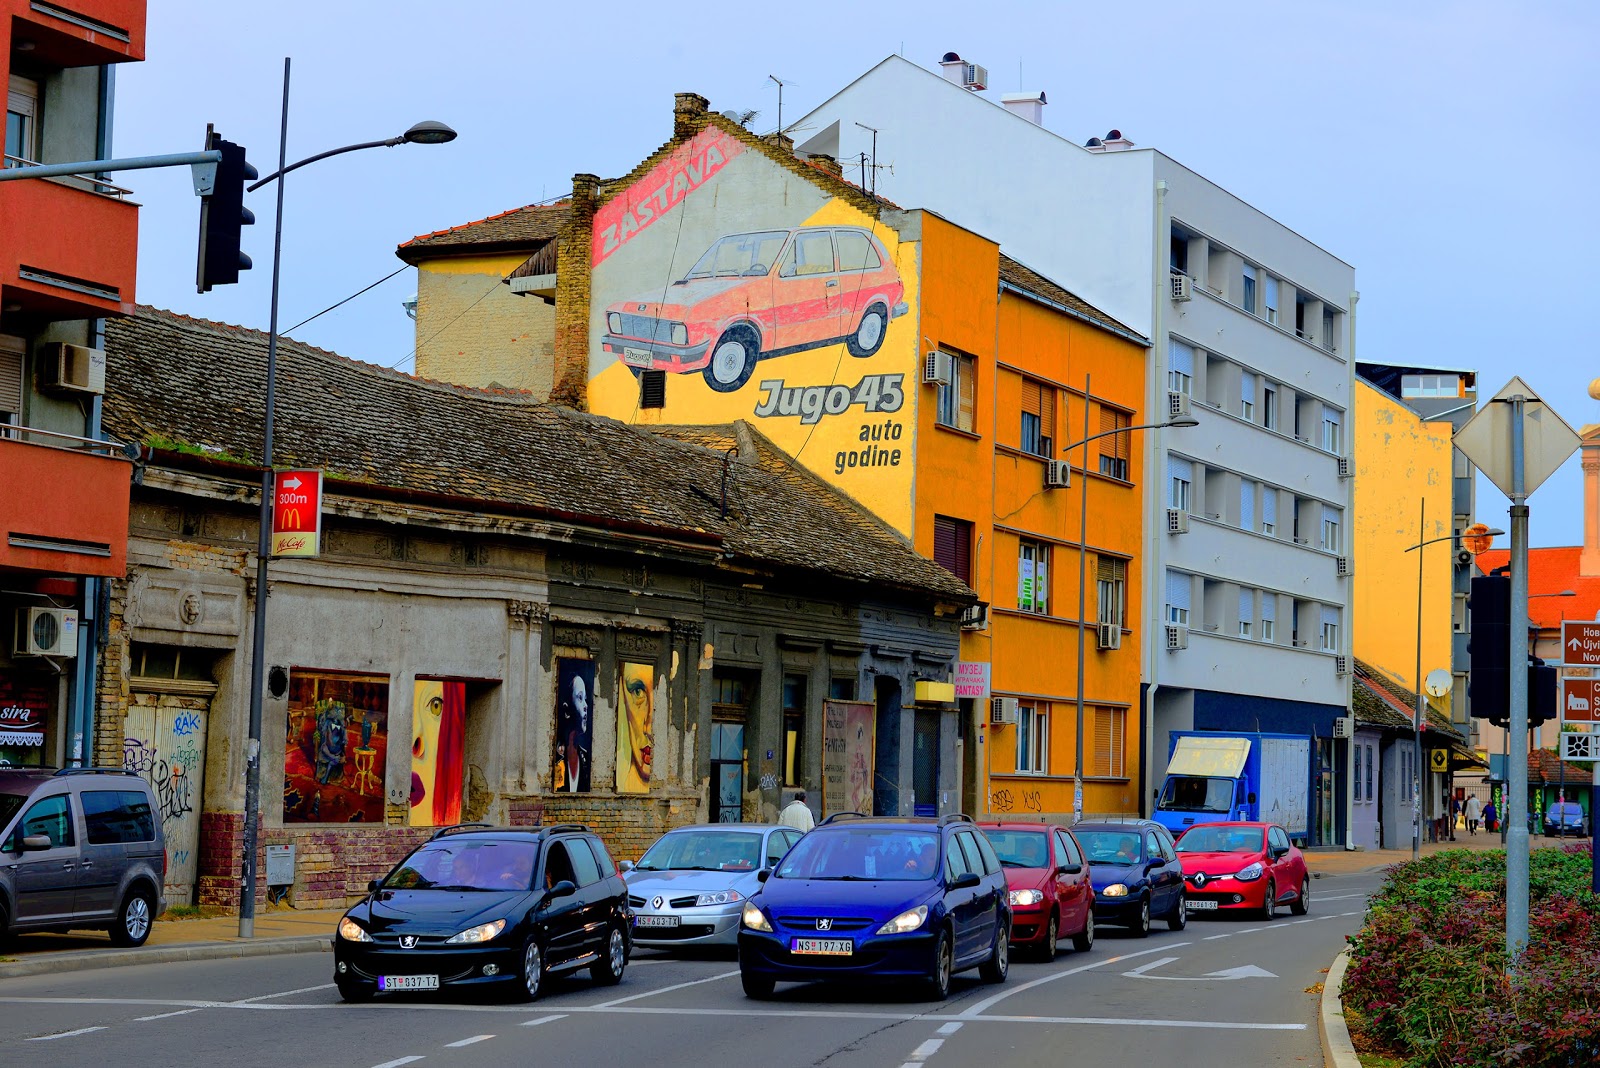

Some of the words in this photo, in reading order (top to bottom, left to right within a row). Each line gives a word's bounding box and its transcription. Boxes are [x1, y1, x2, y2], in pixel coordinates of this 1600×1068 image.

[600, 145, 726, 255] ZASTAVA
[859, 420, 902, 441] auto
[835, 445, 901, 474] godine
[280, 493, 307, 504] 300m
[955, 685, 985, 696] FANTASY
[0, 704, 31, 722] sira
[798, 941, 810, 951] NS
[386, 977, 398, 988] ST
